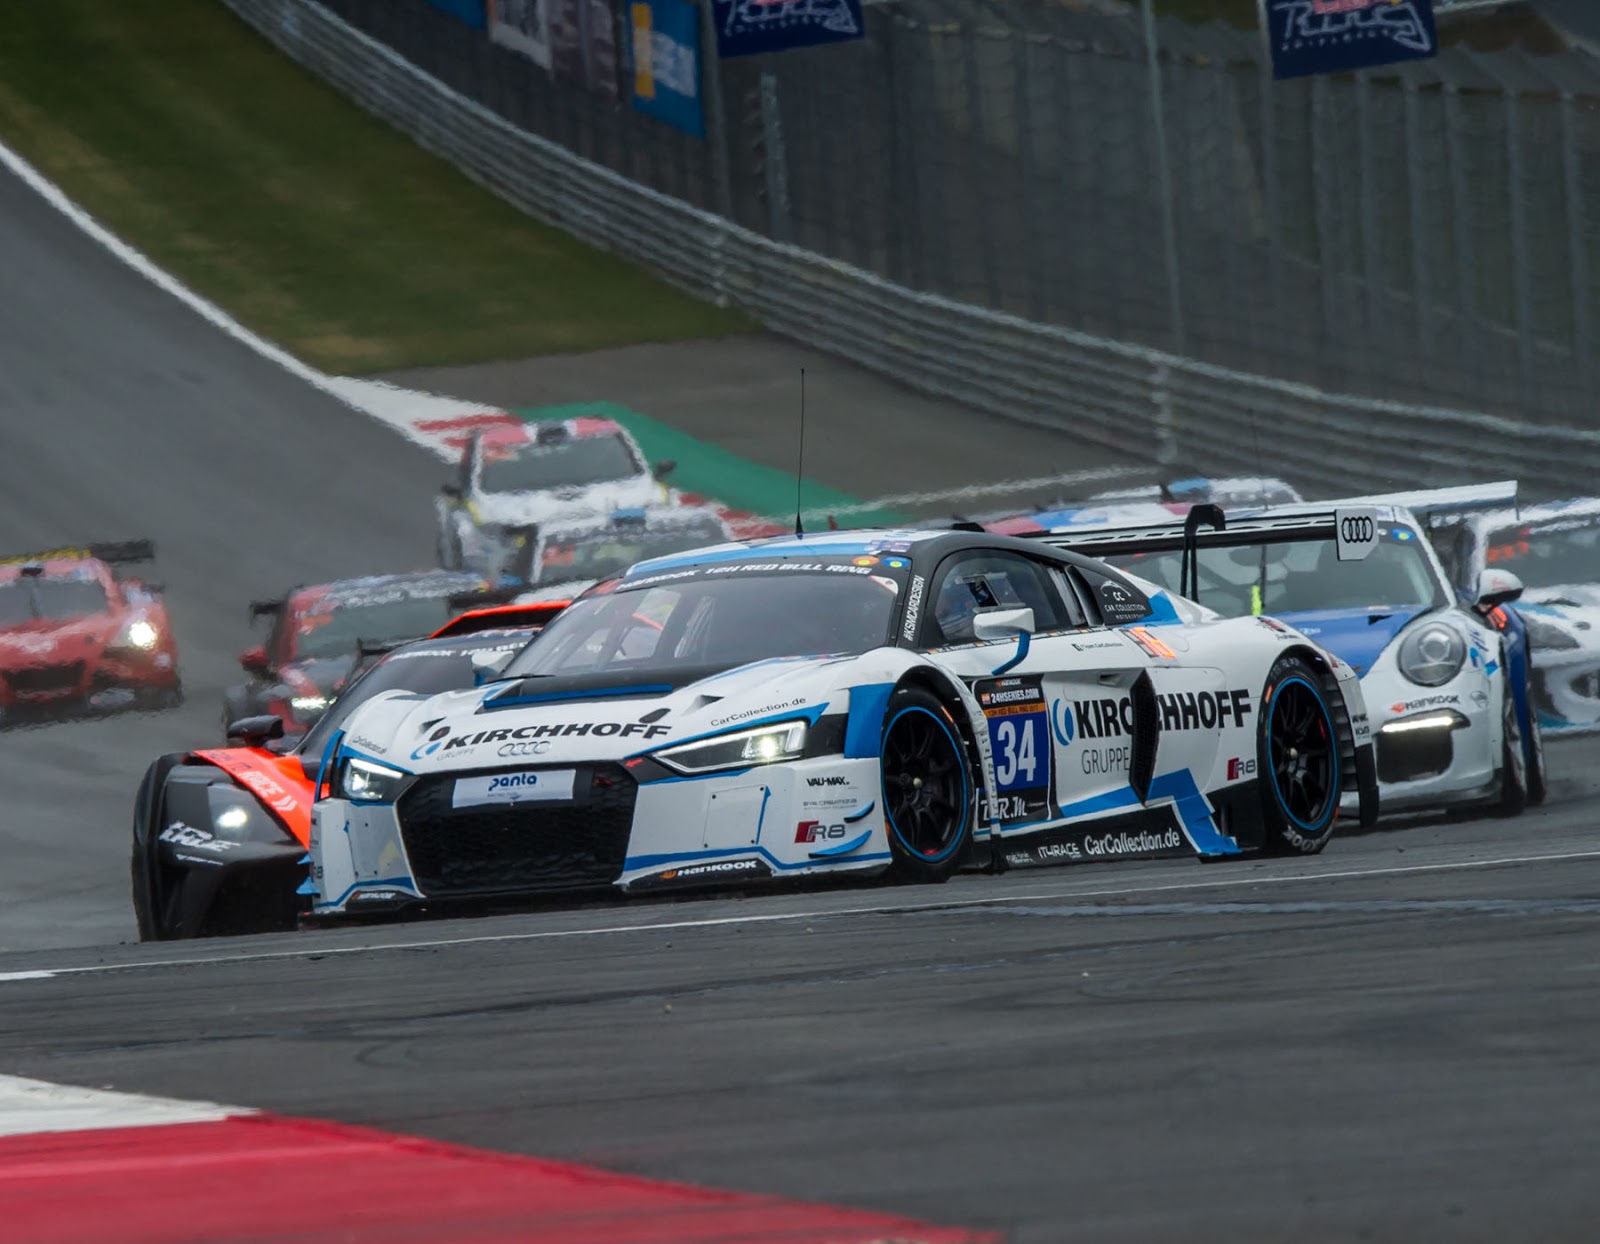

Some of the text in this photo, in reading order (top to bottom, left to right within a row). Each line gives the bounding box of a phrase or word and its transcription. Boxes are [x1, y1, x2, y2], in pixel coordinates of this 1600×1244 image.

[740, 564, 779, 572] RED
[826, 565, 872, 575] RING
[991, 688, 1040, 704] 24HSERIES.COM
[710, 697, 807, 727] CarCollection.de
[443, 722, 672, 751] KIRCHHOFF
[997, 719, 1036, 785] 34
[1081, 748, 1130, 775] GRUPPE
[488, 773, 538, 792] panta
[1084, 827, 1180, 855] CarCollection.de
